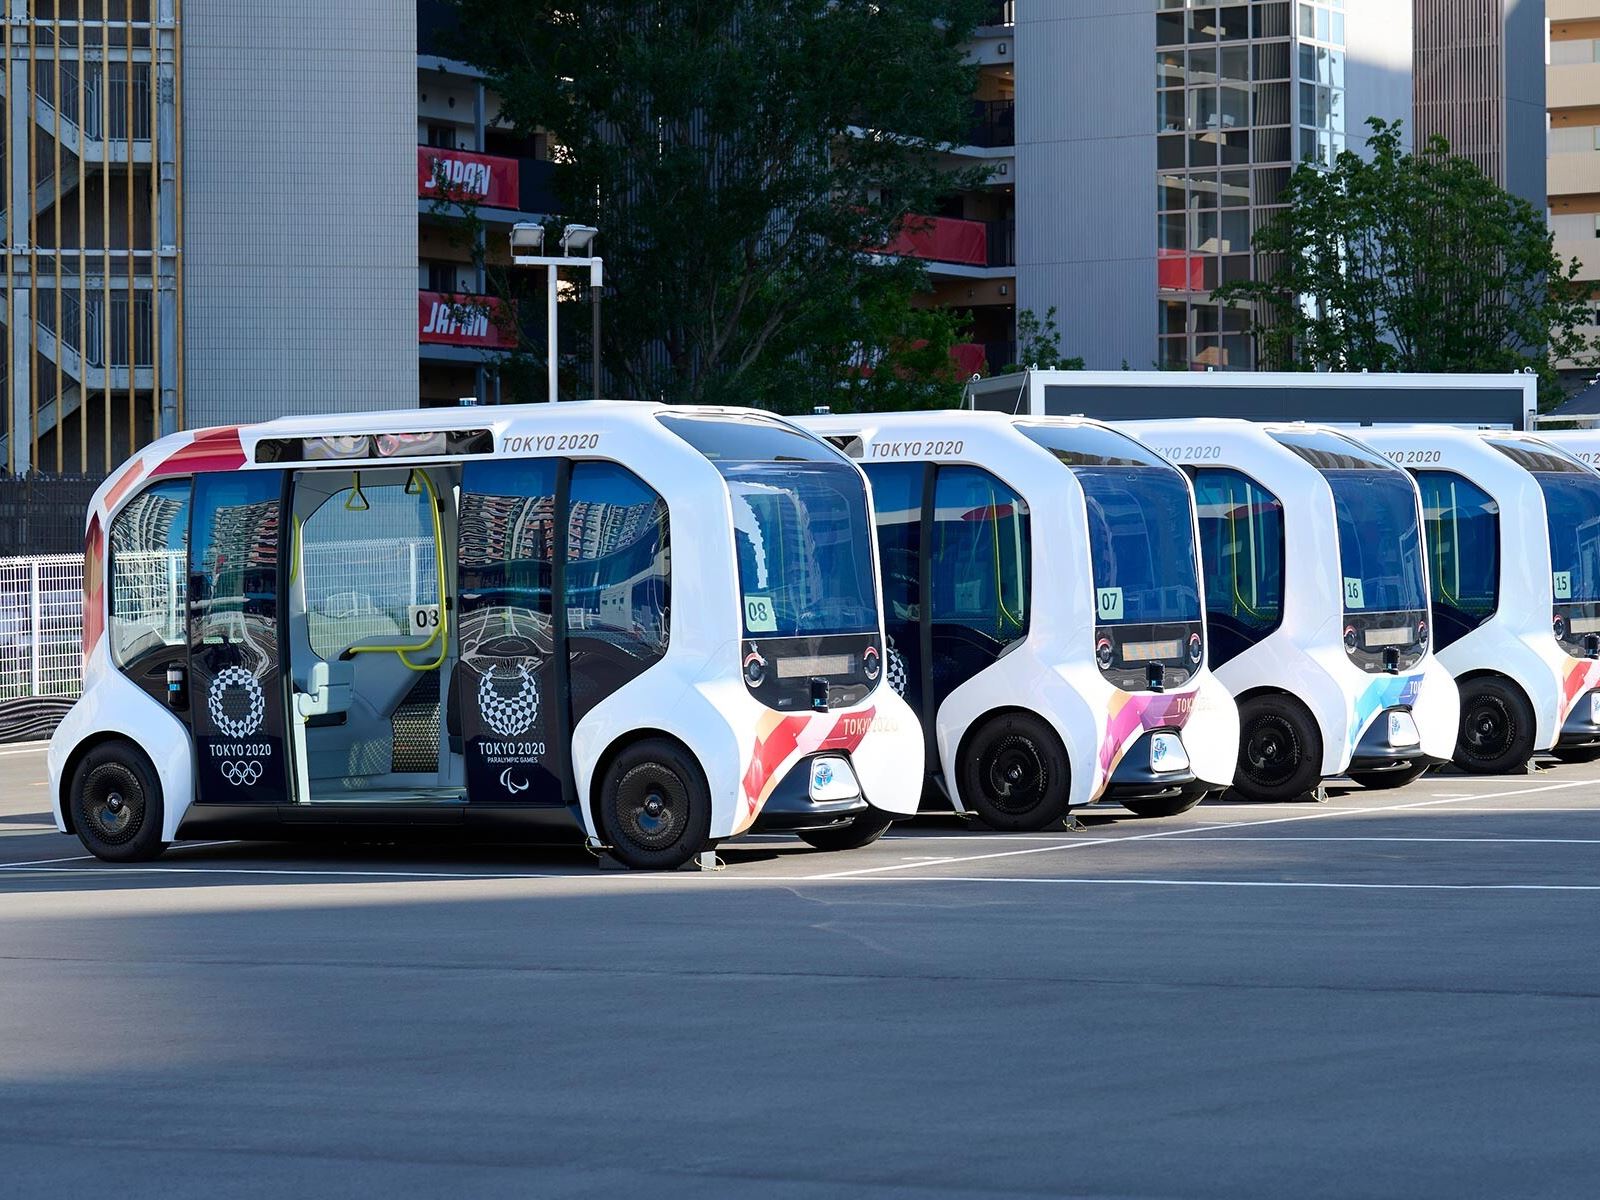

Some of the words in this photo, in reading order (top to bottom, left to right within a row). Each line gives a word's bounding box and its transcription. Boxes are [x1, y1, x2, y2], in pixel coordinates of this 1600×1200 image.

[424, 158, 491, 196] JAPAN
[423, 302, 489, 337] JAPAN
[503, 435, 555, 453] TOKYO
[557, 433, 599, 450] 2020
[872, 442, 922, 457] TOKYO
[924, 441, 964, 456] 2020
[1184, 446, 1221, 460] 2020
[1406, 450, 1441, 463] 2020
[1346, 583, 1358, 598] 16
[1556, 579, 1567, 591] 15
[1102, 592, 1117, 611] 07
[748, 602, 768, 622] 08
[209, 744, 244, 756] TOKYO
[246, 743, 272, 756] 2020
[478, 742, 515, 755] TOKYO
[518, 742, 546, 755] 2020
